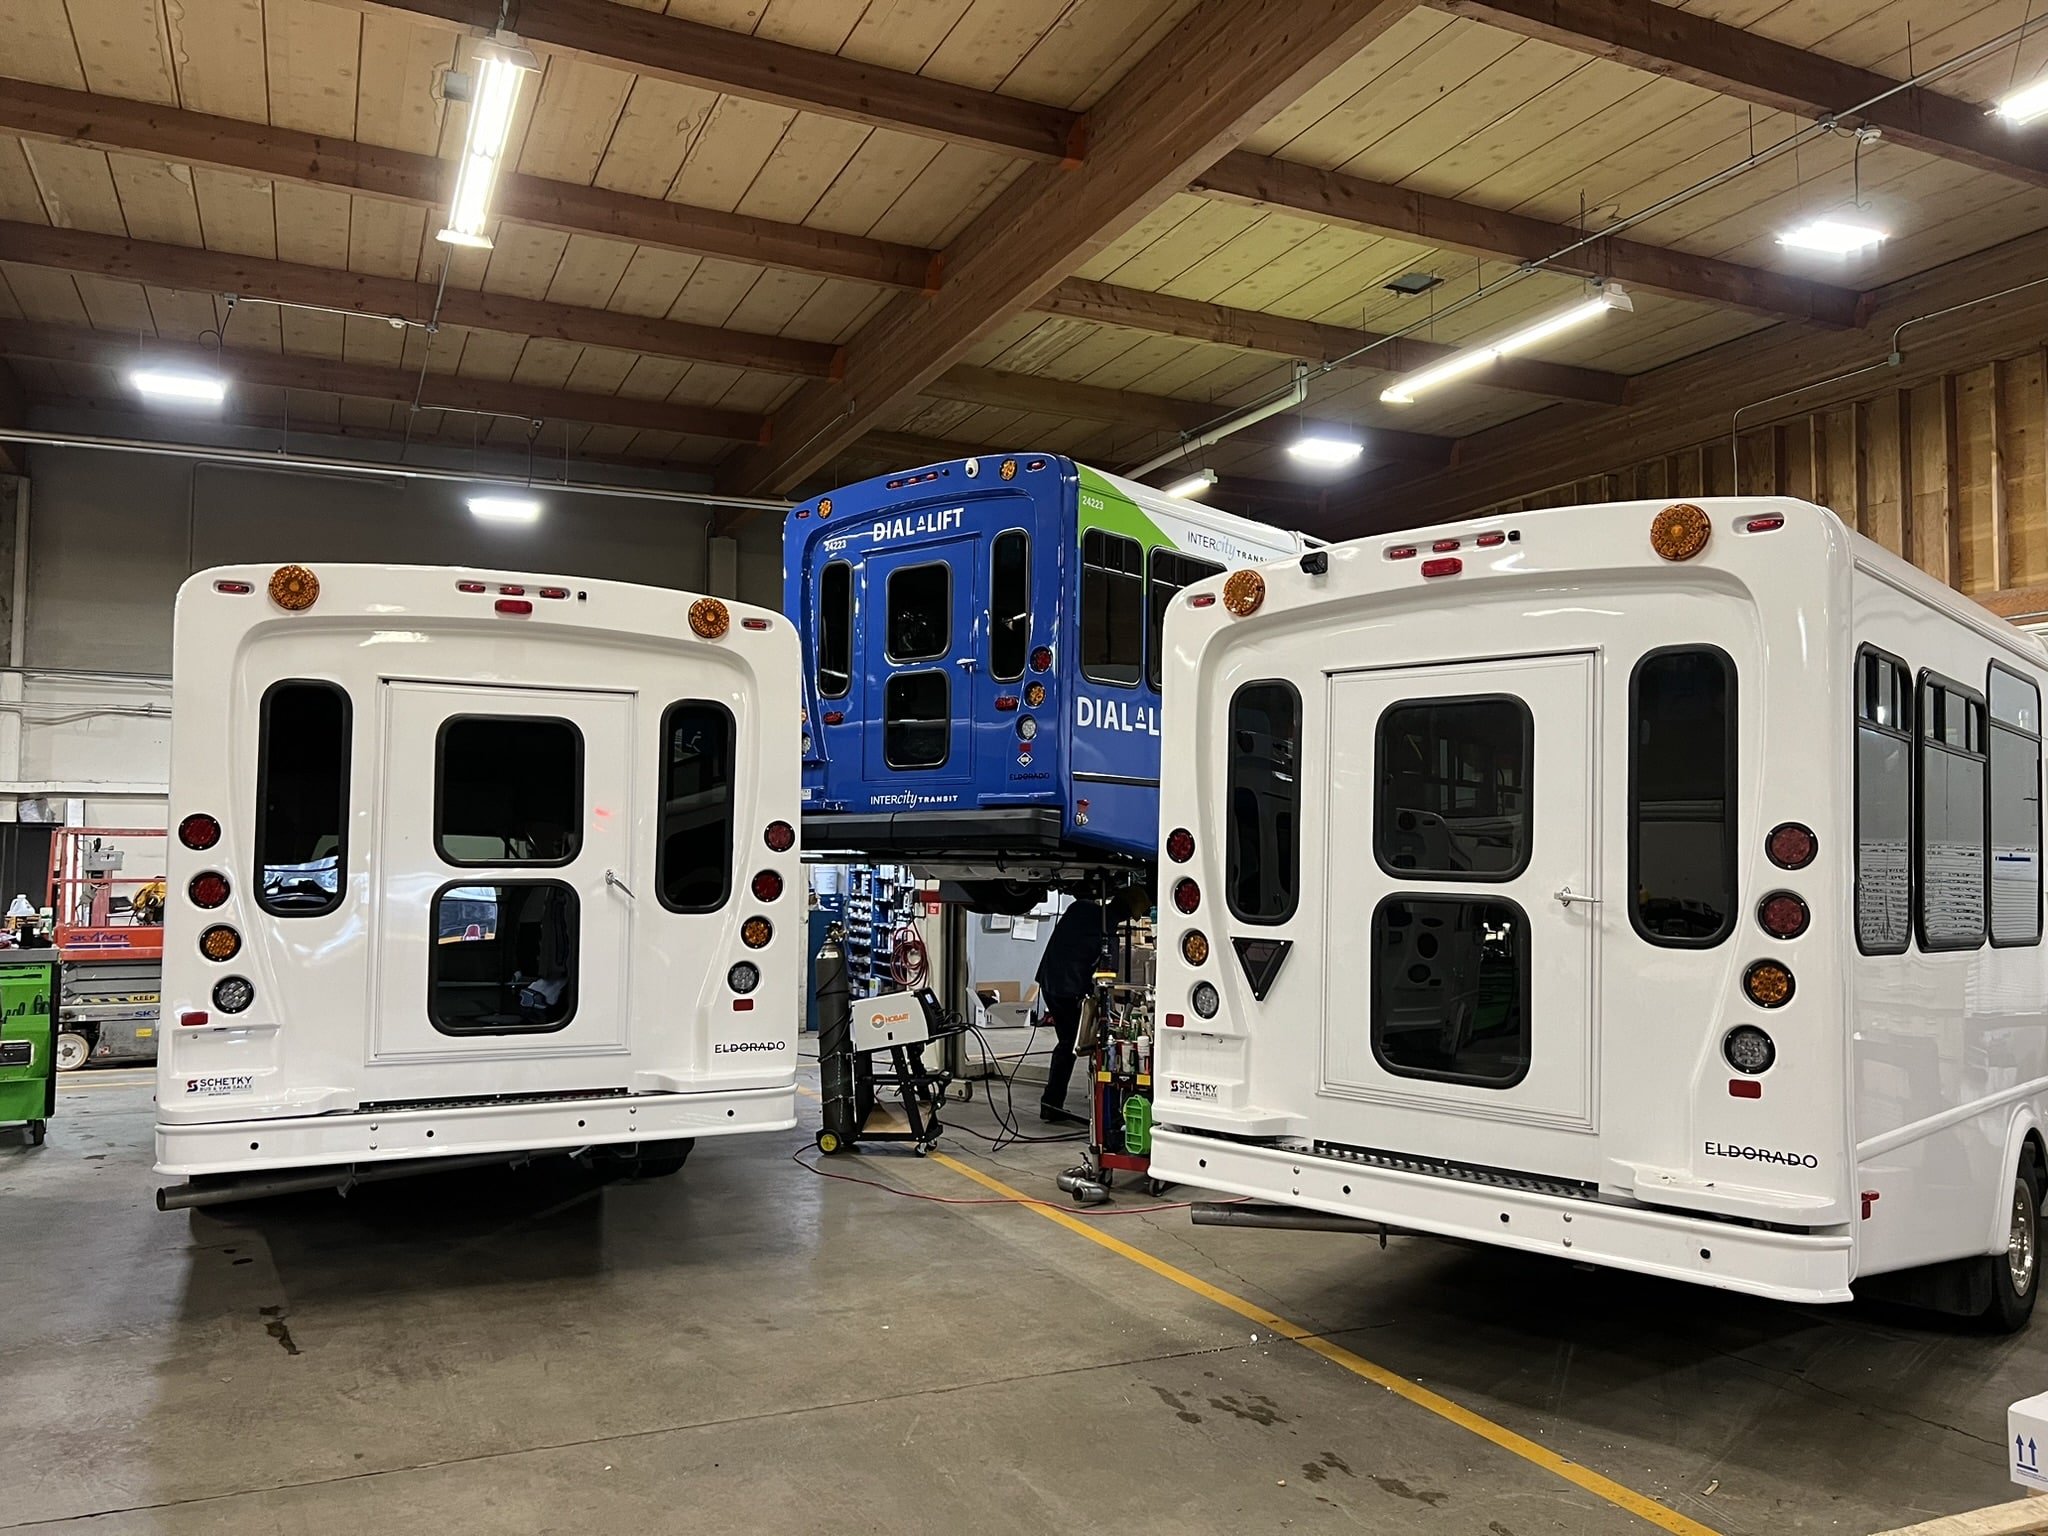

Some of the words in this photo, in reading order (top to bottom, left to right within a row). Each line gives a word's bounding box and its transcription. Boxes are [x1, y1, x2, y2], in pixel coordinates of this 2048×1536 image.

[1082, 495, 1104, 511] 24223
[873, 516, 915, 542] DIAL
[927, 507, 965, 533] LIFT
[824, 540, 847, 552] 24223
[1077, 696, 1133, 732] DIAL
[1009, 772, 1050, 781] ELDORADO
[133, 994, 156, 1002] KEEP
[885, 1013, 910, 1024] HOBART
[714, 1040, 786, 1054] ELDORADO
[199, 1075, 252, 1087] SCHETKY
[1179, 1080, 1217, 1093] SCHETKY
[1705, 1141, 1819, 1169] ELDORADO
